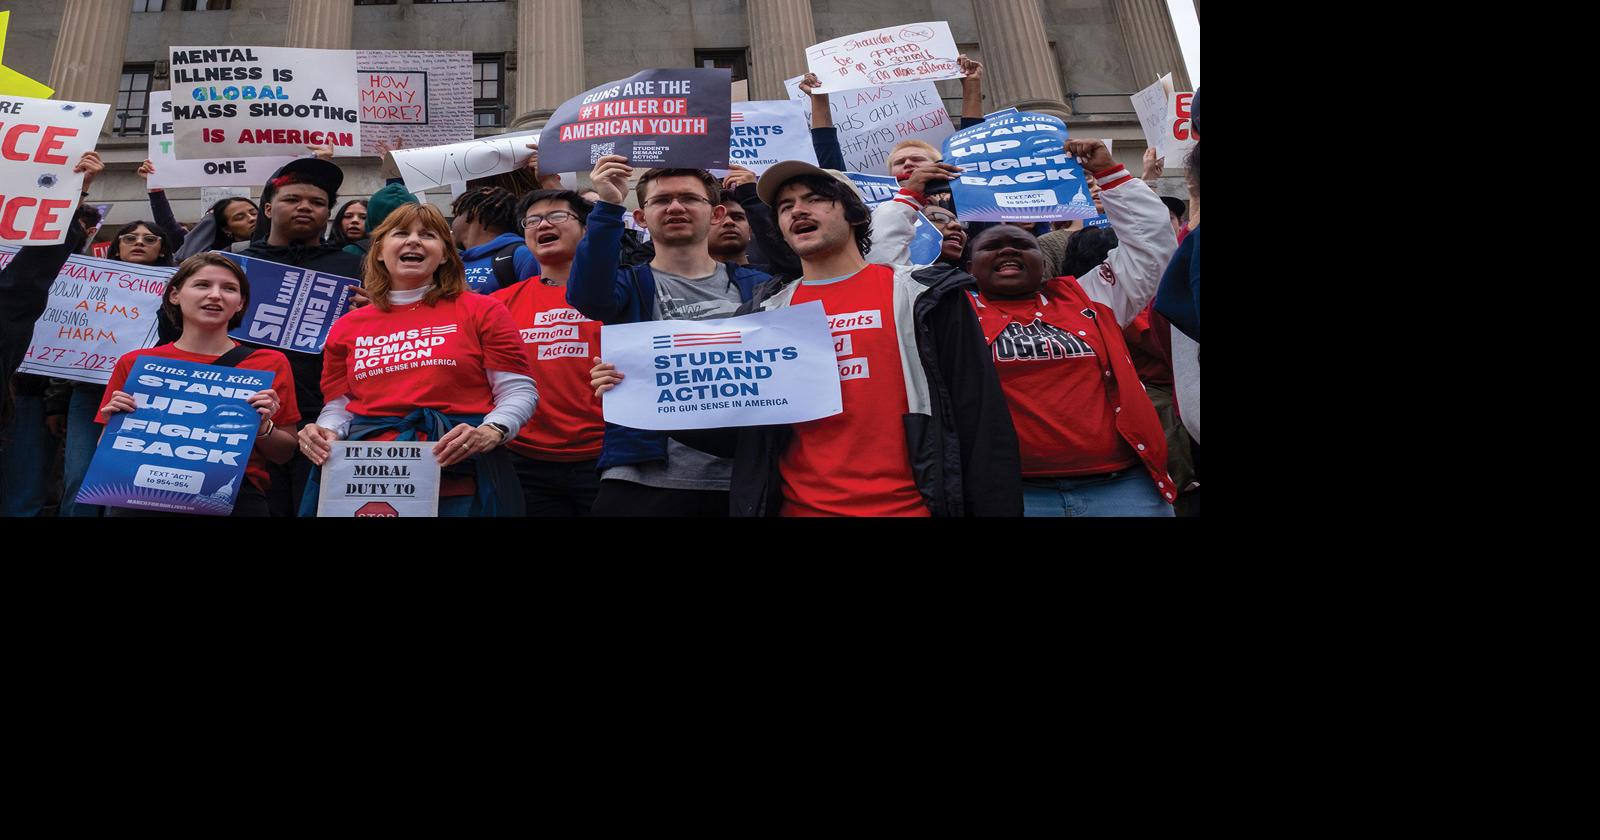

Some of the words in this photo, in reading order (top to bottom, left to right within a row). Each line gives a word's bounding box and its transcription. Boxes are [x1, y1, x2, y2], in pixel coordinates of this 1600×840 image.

[172, 48, 258, 65] MENTAL
[174, 67, 262, 83] ILLNESS
[272, 68, 293, 82] IS
[370, 74, 408, 88] HOW
[192, 85, 288, 102] GLOBAL
[312, 88, 328, 102] A
[362, 89, 416, 104] MANY
[582, 86, 620, 104] GUNS
[622, 81, 654, 96] ARE
[658, 80, 691, 94] THE
[842, 86, 892, 109] LAWS
[174, 104, 238, 120] MASS
[249, 102, 358, 123] SHOOTING
[362, 105, 422, 122] MORE?
[582, 104, 600, 119] #1
[604, 100, 659, 116] KILLER
[662, 100, 684, 114] OF
[202, 128, 225, 143] IS
[238, 128, 354, 147] AMERICAN
[562, 120, 644, 140] AMERICAN
[649, 118, 705, 134] YOUTH
[730, 125, 784, 136] ENTS
[950, 124, 1059, 148] STAND
[0, 122, 79, 165] CE
[951, 140, 1020, 158] UP
[203, 160, 247, 174] ONE
[957, 154, 1068, 173] FIGHT
[960, 168, 1078, 186] BACK
[0, 195, 72, 240] CE
[87, 285, 109, 302] YOUR
[276, 271, 300, 304] WITH
[313, 277, 337, 297] IT
[43, 307, 88, 326] CAUSING
[75, 300, 140, 320] ARMS
[540, 310, 587, 323] Studen
[249, 303, 288, 342] US
[295, 297, 330, 348] ENDS
[58, 326, 117, 344] HARM
[355, 329, 419, 347] MOMS
[521, 327, 573, 340] Demand
[354, 336, 445, 359] DEMAND
[543, 344, 584, 357] Action
[354, 348, 432, 372] ACTION
[654, 346, 798, 370] STUDENTS
[144, 363, 188, 377] Guns.
[191, 370, 222, 382] Kill.
[225, 375, 263, 386] Kids.
[355, 372, 368, 381] FOR
[369, 368, 384, 377] GUN
[385, 364, 409, 373] SENSE
[420, 358, 457, 366] AMERICA
[656, 366, 772, 386] DEMAND
[137, 375, 258, 400] STAND
[657, 382, 759, 403] ACTION
[132, 392, 208, 415] UP
[658, 406, 676, 414] FOR
[679, 404, 698, 412] GUN
[700, 401, 729, 411] SENSE
[745, 398, 788, 407] AMERICA
[120, 418, 248, 446] FIGHT
[112, 436, 242, 466] BACK
[345, 447, 362, 458] IT
[366, 447, 382, 458] IS
[387, 447, 421, 458] OUR
[149, 470, 169, 478] TEXT
[170, 472, 193, 481] "ACT"
[353, 465, 411, 476] MORAL
[156, 479, 189, 488] 954-954
[346, 484, 389, 494] DUTY
[394, 484, 415, 494] TO
